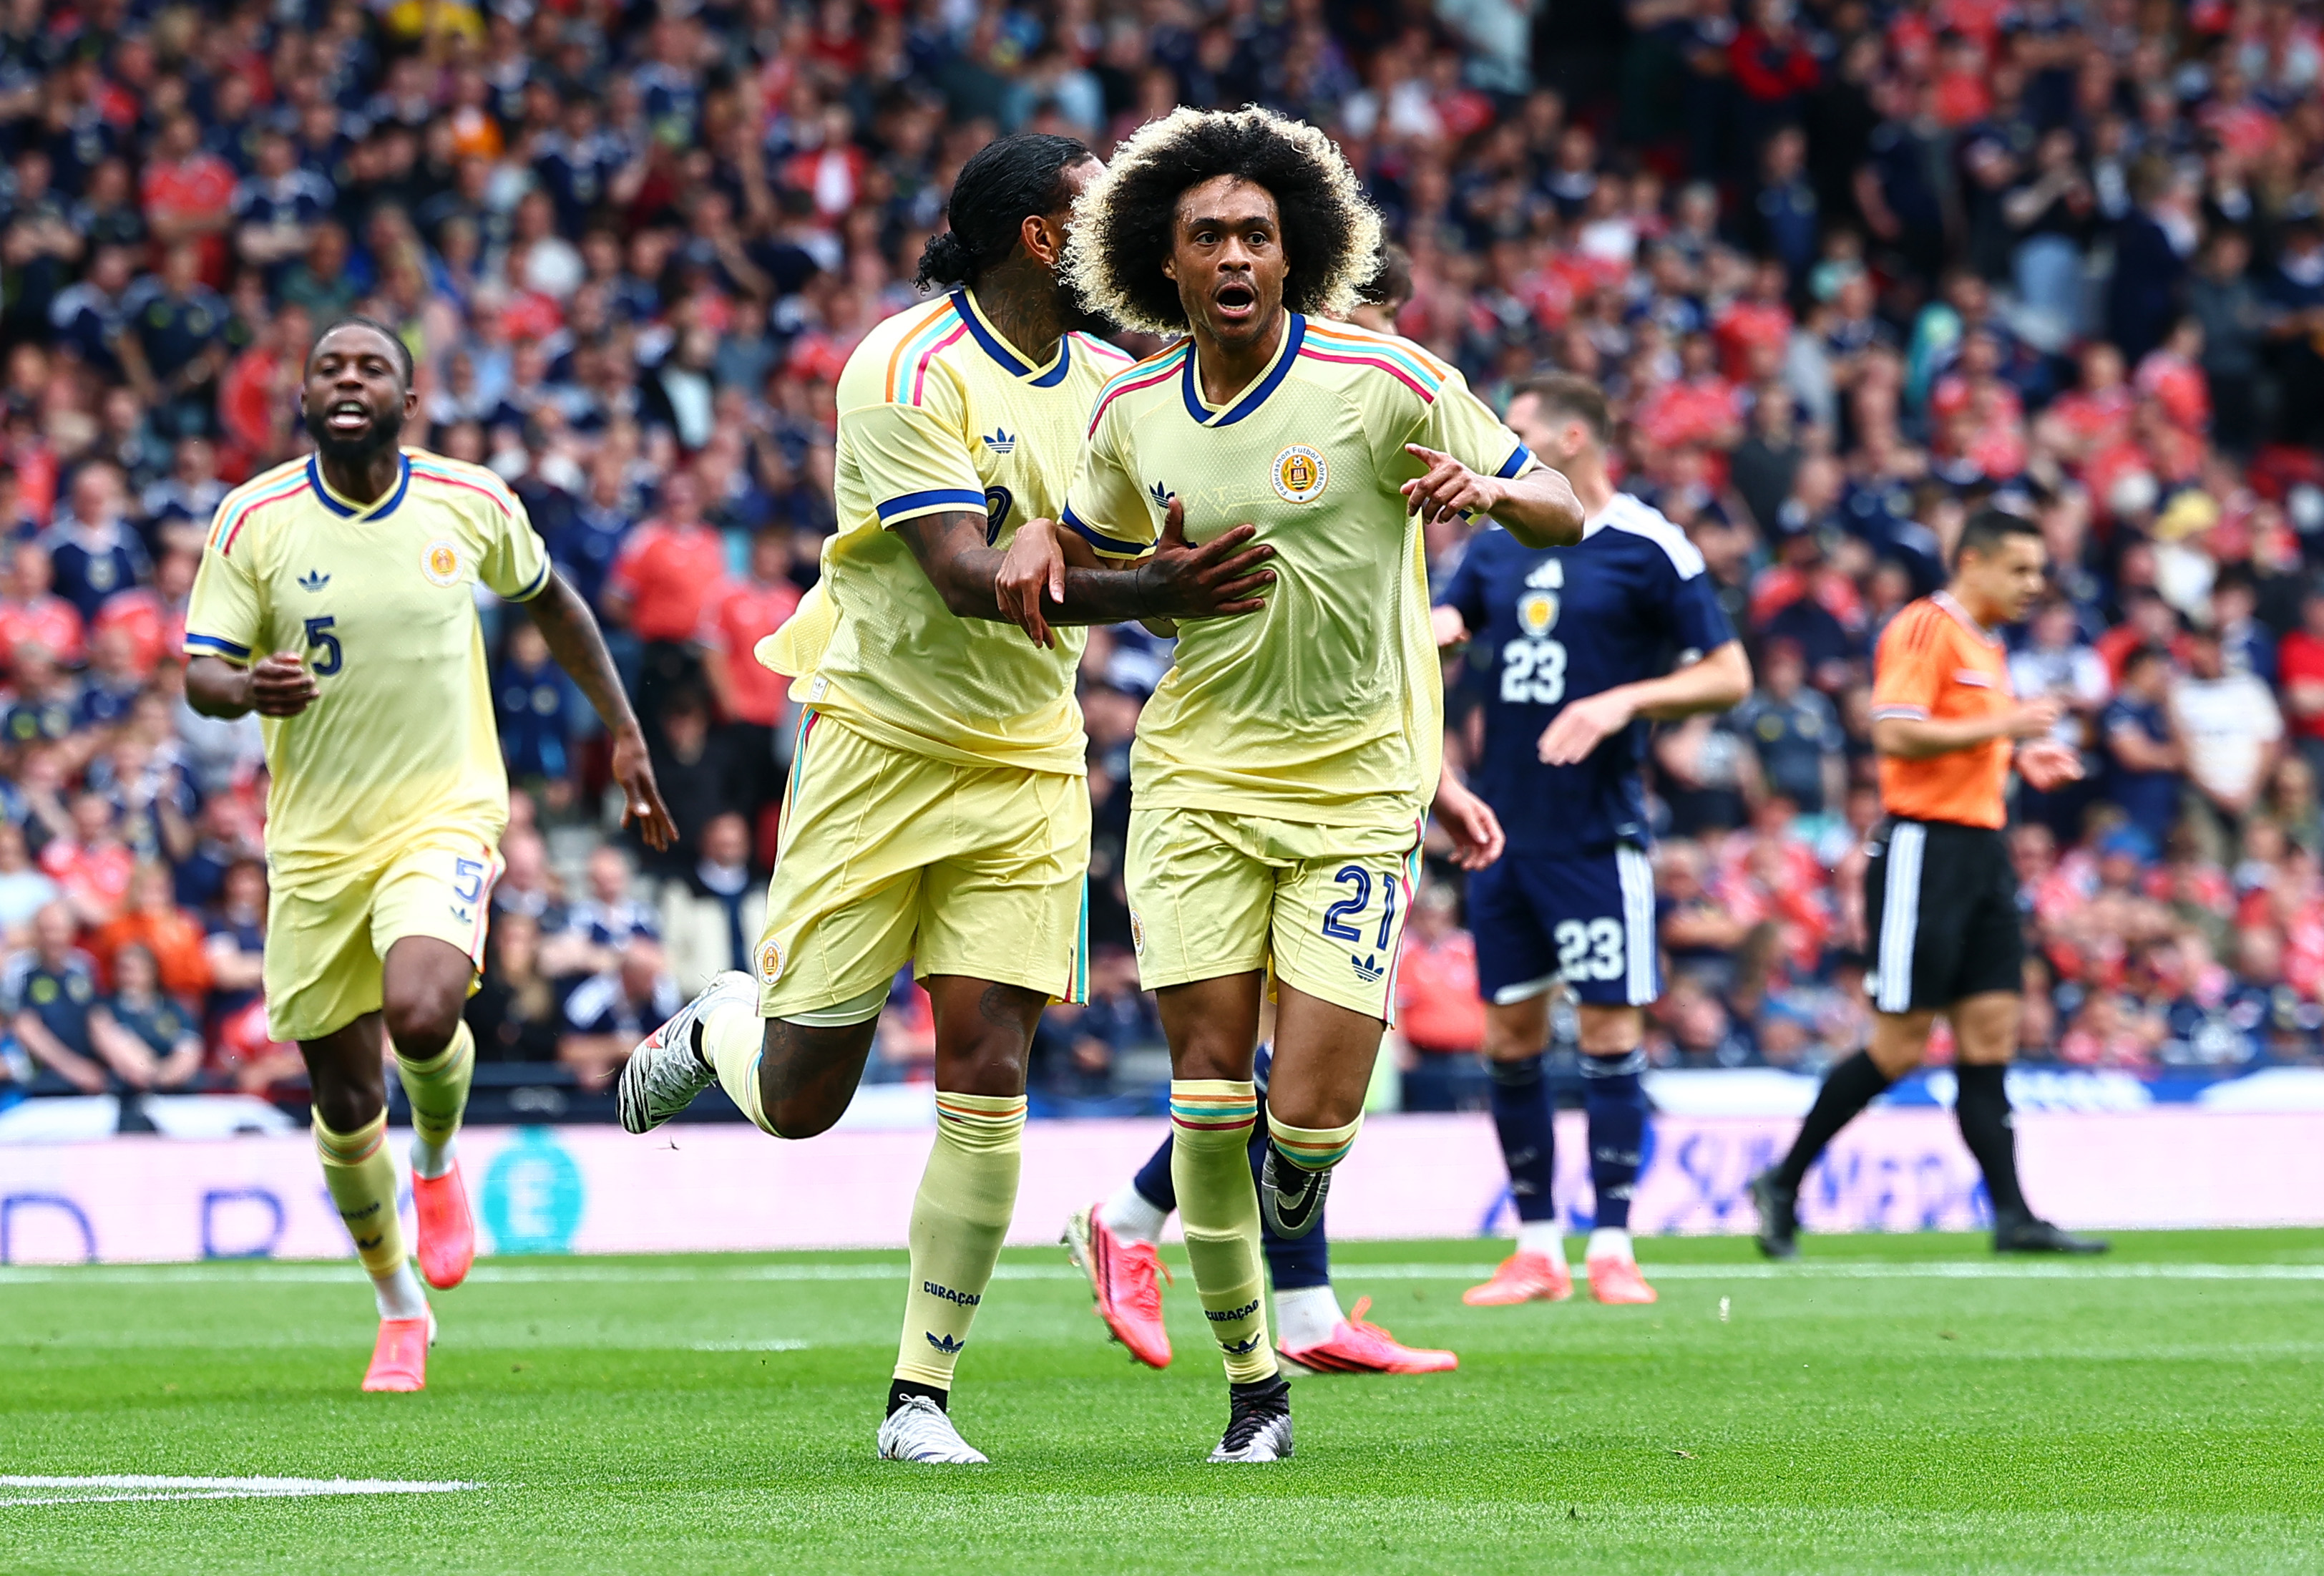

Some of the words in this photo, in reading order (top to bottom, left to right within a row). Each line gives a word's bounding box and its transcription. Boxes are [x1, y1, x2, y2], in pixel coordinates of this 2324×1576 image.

[1274, 450, 1291, 496] Federashon
[305, 616, 342, 676] 5
[1500, 638, 1568, 704] 23
[454, 857, 483, 904] 5
[1322, 865, 1395, 950] 21
[1554, 916, 1624, 981] 23
[924, 1281, 981, 1307] CURAÇAO
[1204, 1299, 1259, 1321] CURAÇAO
